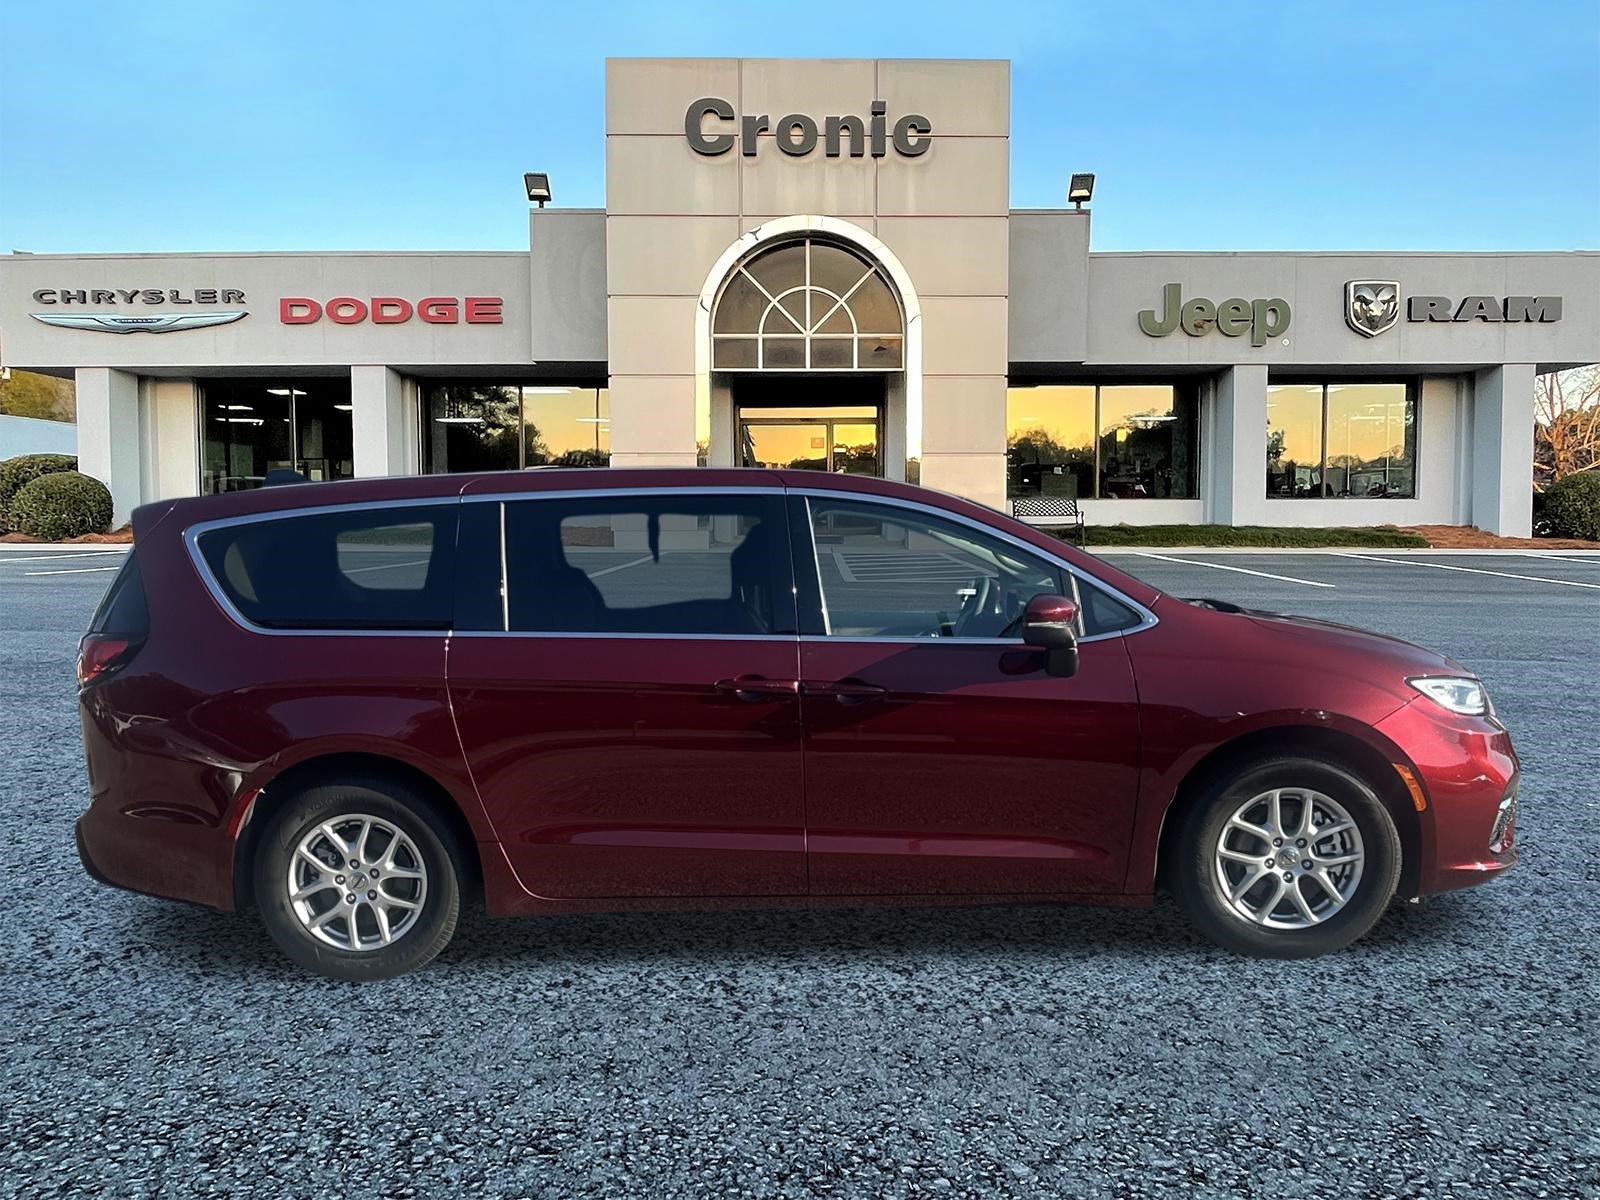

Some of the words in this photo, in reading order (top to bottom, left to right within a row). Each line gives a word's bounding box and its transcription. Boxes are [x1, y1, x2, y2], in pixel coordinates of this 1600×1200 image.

[684, 97, 932, 158] Cronic
[32, 289, 247, 305] CHRYSLER
[280, 297, 503, 325] DODGE
[1407, 296, 1563, 323] RAM
[1138, 283, 1291, 347] Jeep
